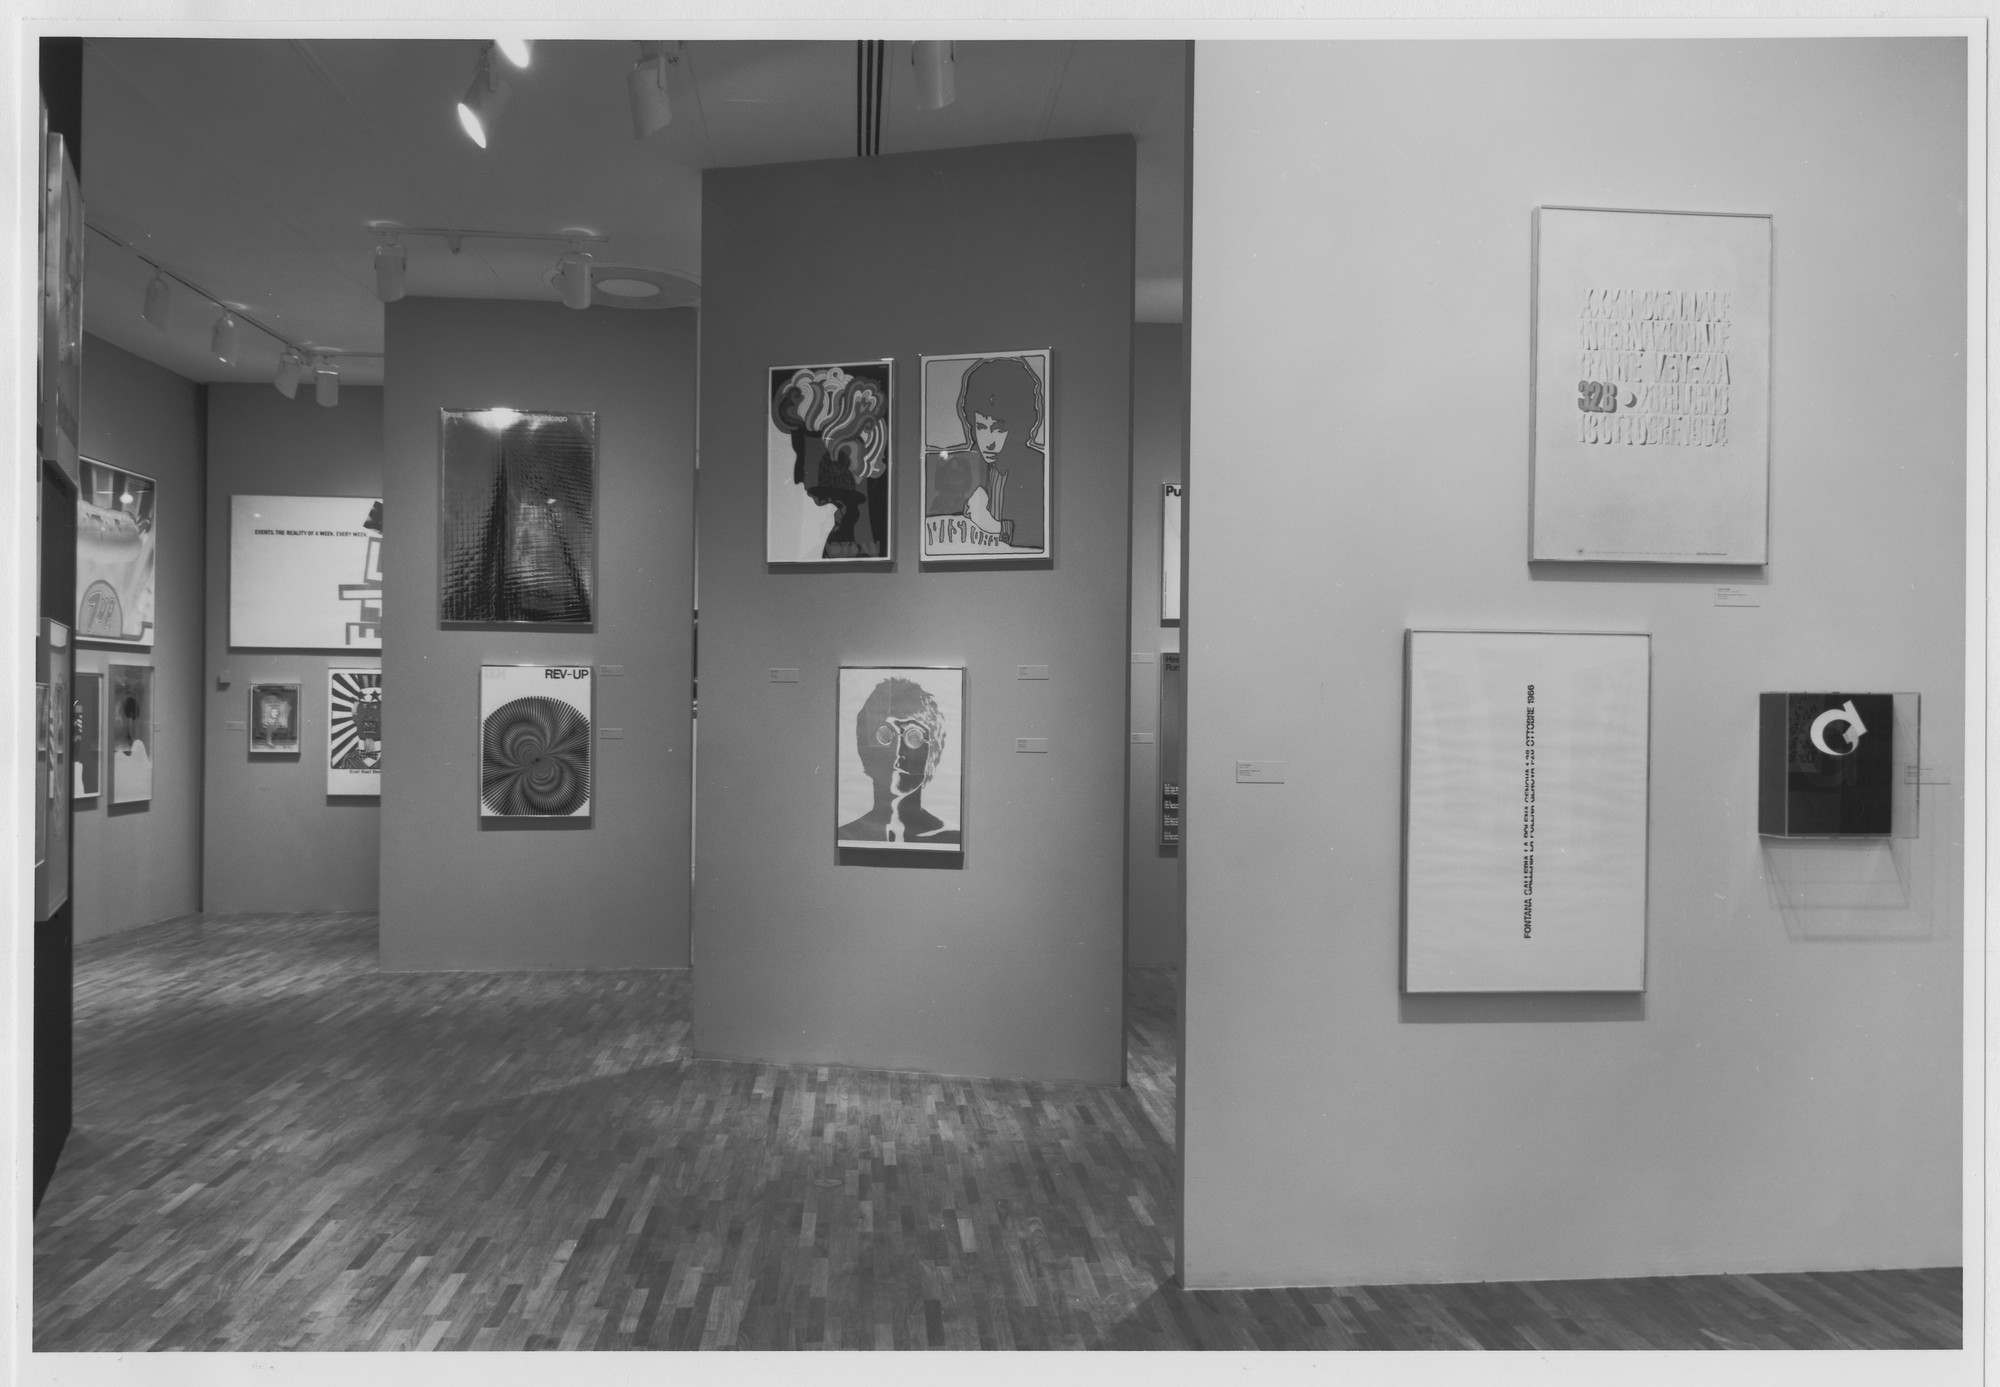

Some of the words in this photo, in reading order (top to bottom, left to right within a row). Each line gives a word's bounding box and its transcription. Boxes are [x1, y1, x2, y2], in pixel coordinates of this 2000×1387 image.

[1653, 353, 1732, 385] VENEZIA
[1578, 380, 1618, 413] 32B
[545, 669, 589, 680] REV-UP
[1526, 684, 1535, 704] 1966
[1525, 706, 1535, 747] OTTOBRE
[1523, 898, 1533, 940] FONTANA
